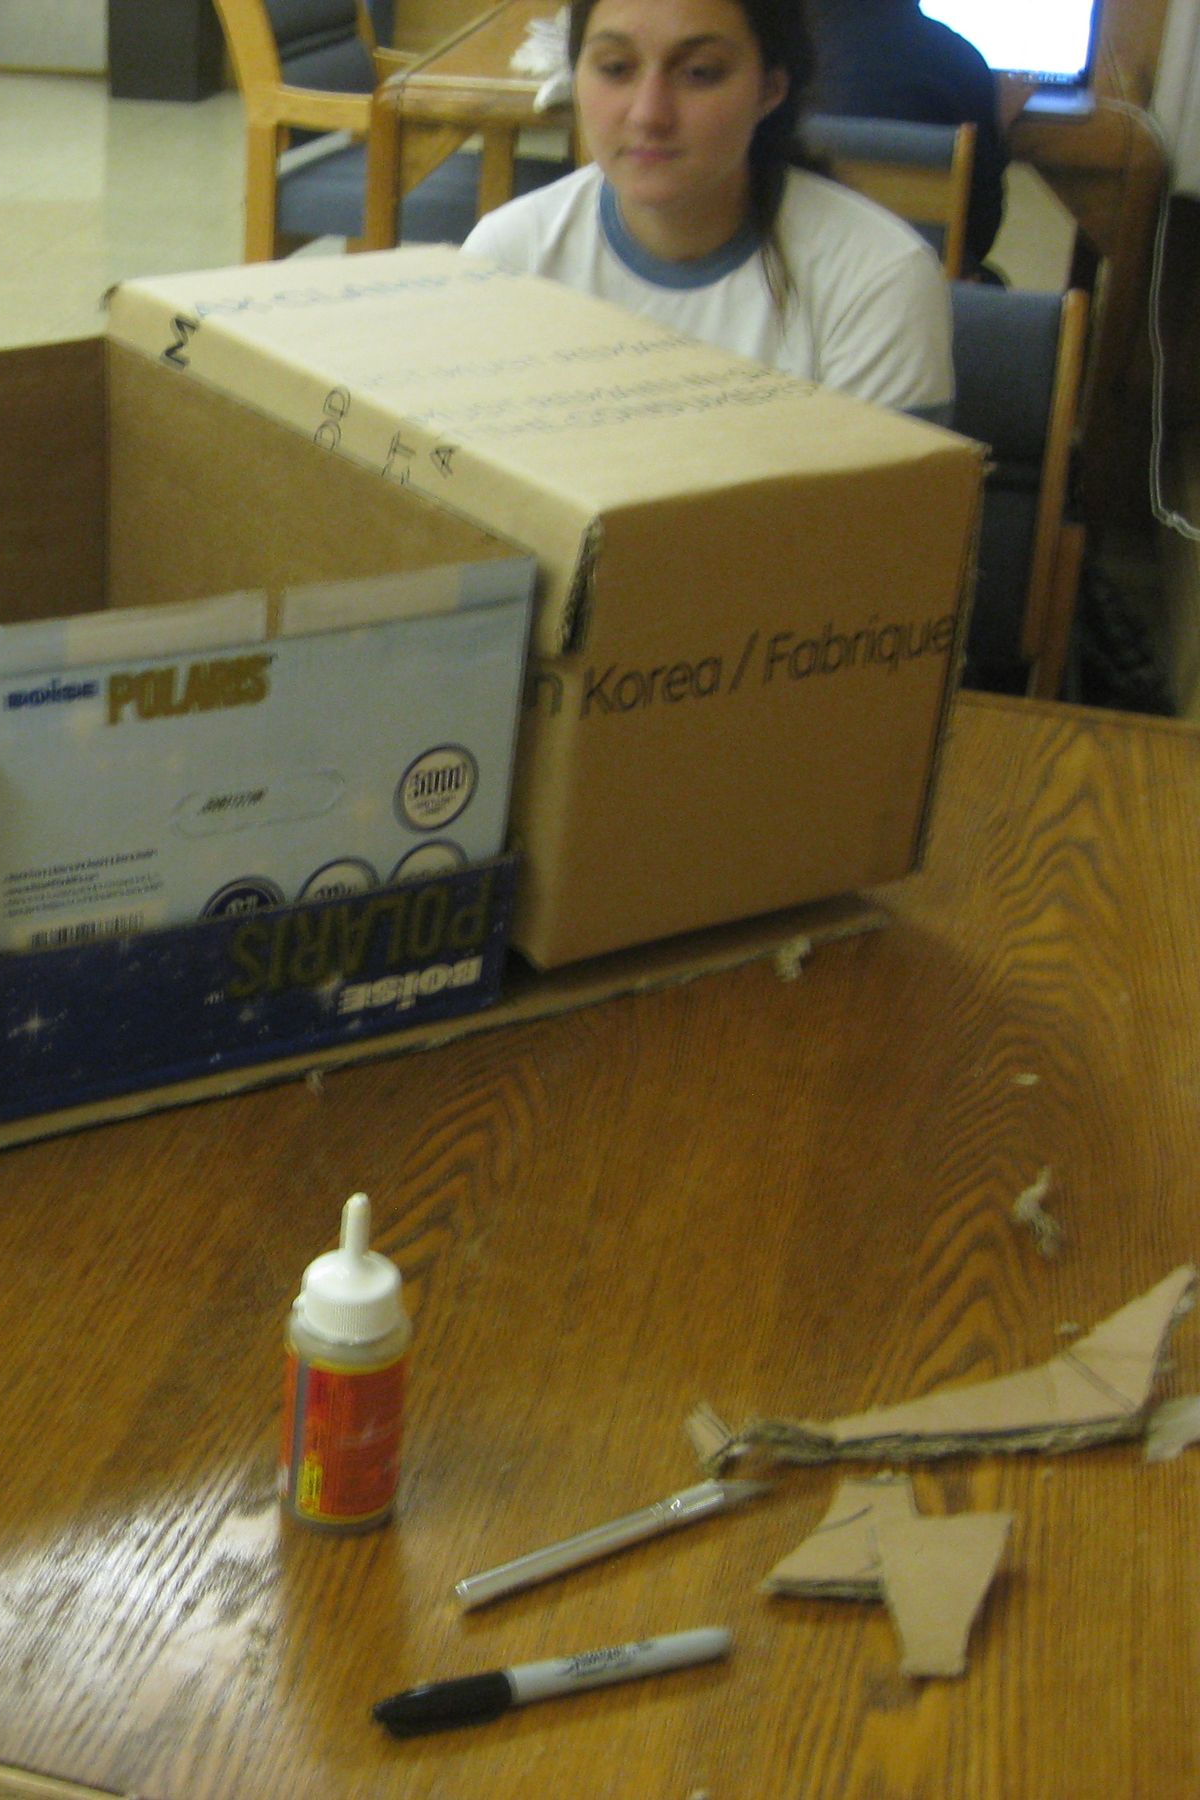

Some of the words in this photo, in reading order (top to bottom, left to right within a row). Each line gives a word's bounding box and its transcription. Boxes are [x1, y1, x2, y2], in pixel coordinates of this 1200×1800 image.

[580, 654, 722, 722] Korea
[728, 629, 761, 695] /
[763, 612, 958, 684] Fabrique
